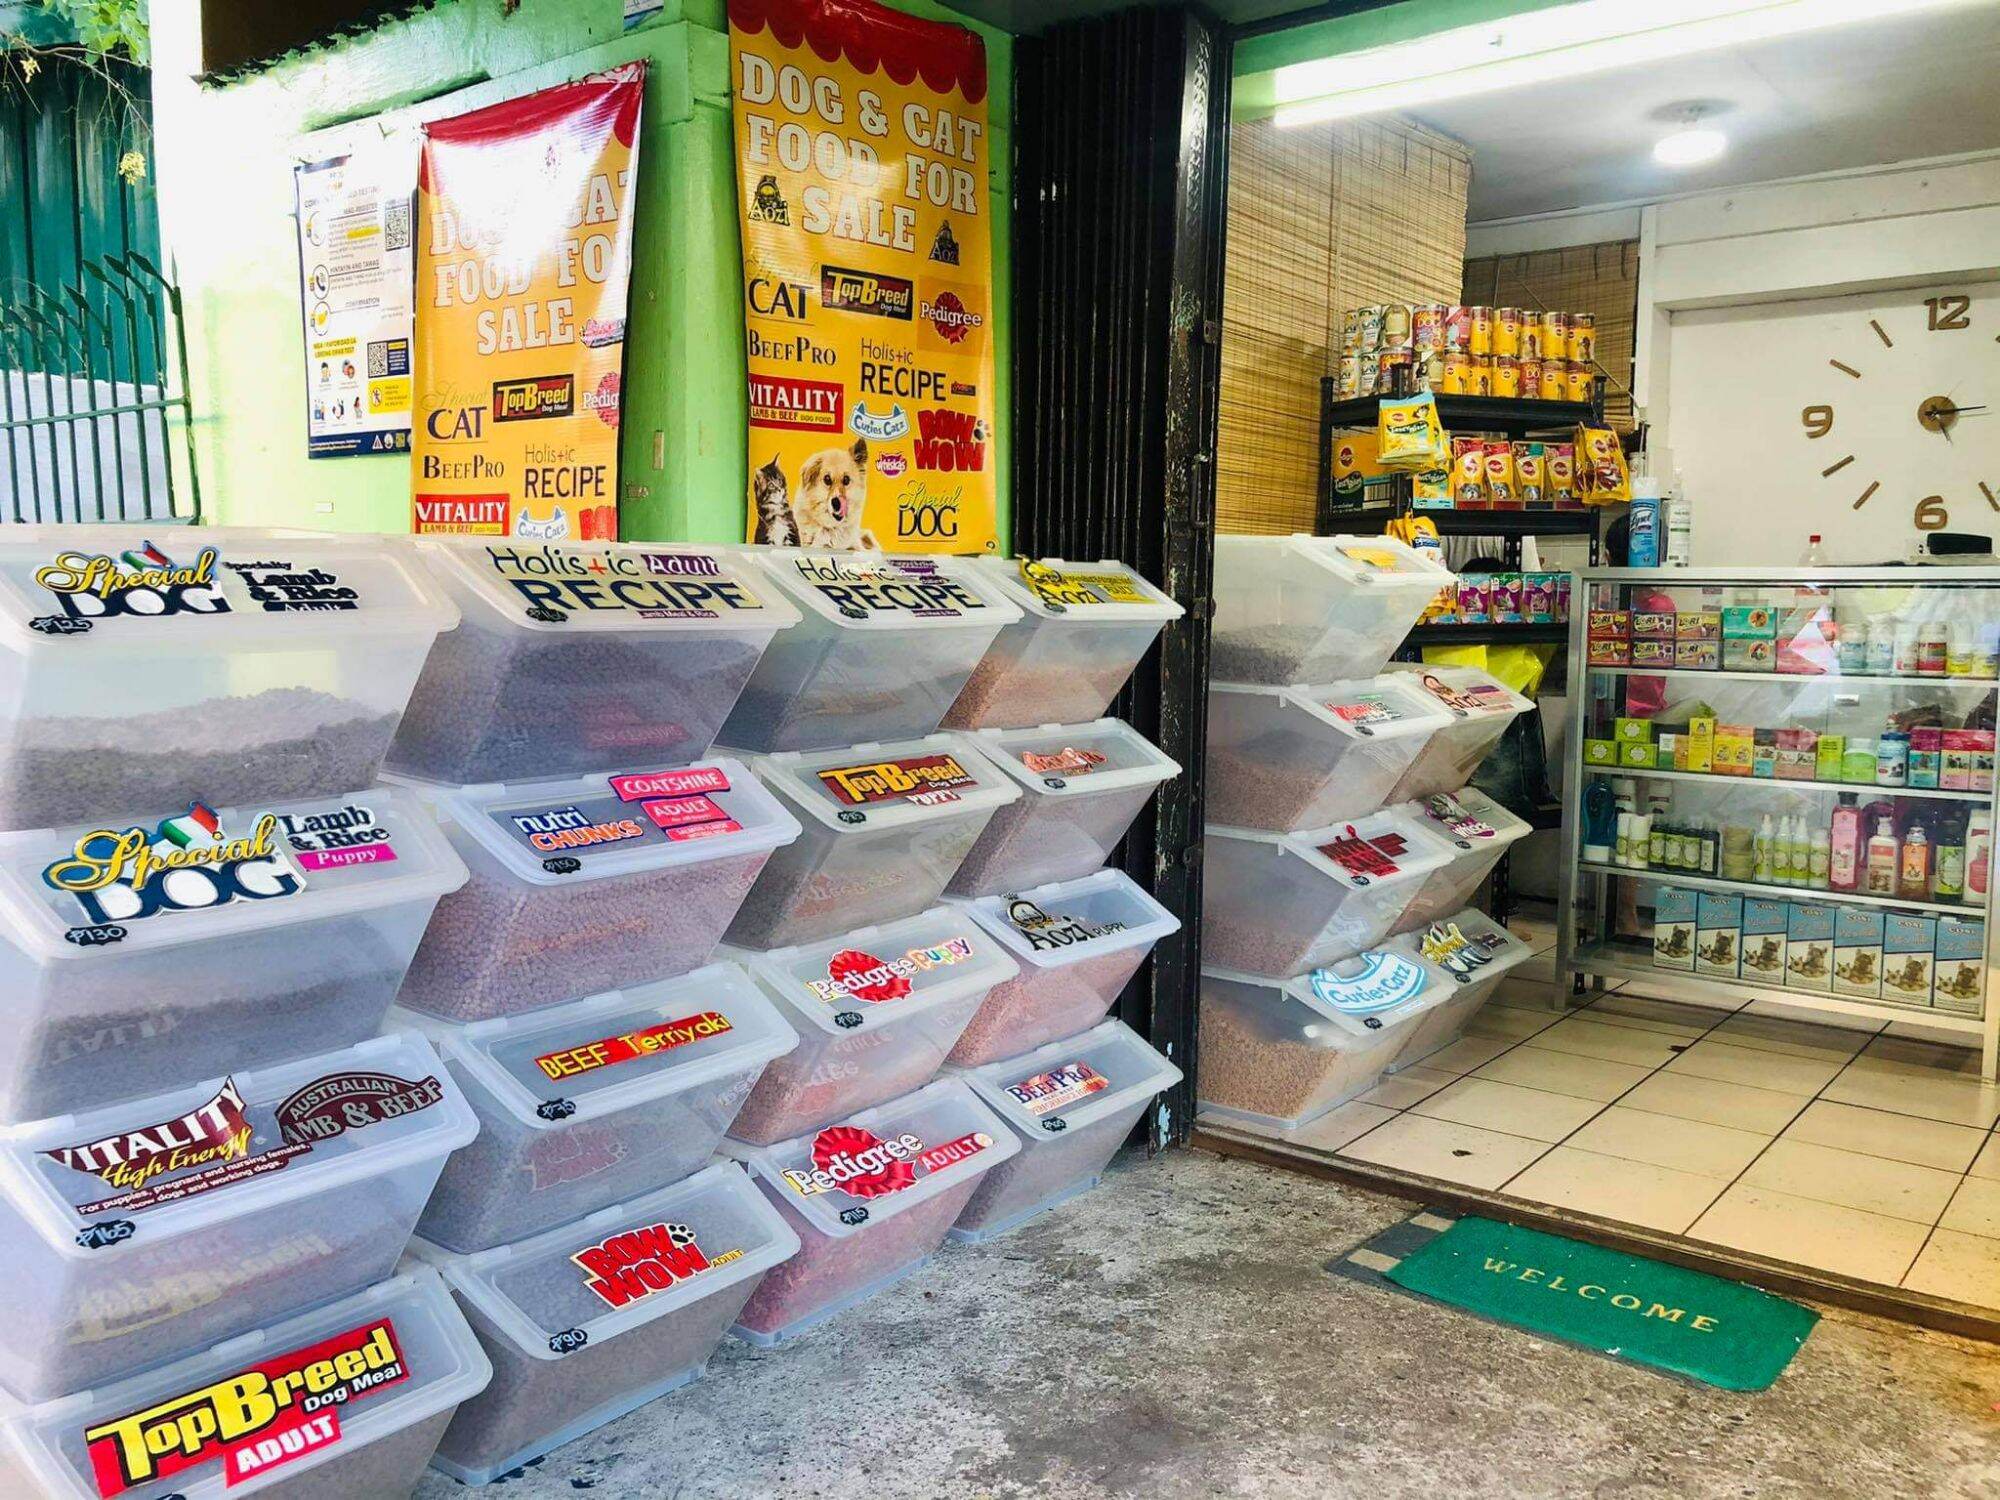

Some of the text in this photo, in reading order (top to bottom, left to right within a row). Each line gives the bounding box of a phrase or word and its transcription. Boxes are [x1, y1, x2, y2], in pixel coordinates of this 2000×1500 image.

[740, 51, 981, 163] DOG & CAT
[747, 114, 977, 215] FOOD FOR
[803, 186, 915, 253] SALE
[434, 254, 533, 307] FOOD
[557, 233, 617, 288] FO
[749, 279, 815, 320] CAT
[826, 273, 909, 308] TopBreed
[476, 297, 575, 355] SALE
[920, 301, 982, 329] Pedigree
[1924, 295, 1970, 331] 12
[861, 338, 914, 364] Holistic
[582, 389, 619, 409] Pedig
[749, 382, 838, 412] VITALITY
[860, 362, 946, 401] RECIPE
[497, 383, 570, 416] TopBreed
[752, 409, 769, 419] LAMB
[778, 410, 797, 421] BEEF
[427, 406, 488, 440] CAT
[917, 409, 976, 443] BOW
[1802, 405, 1834, 438] 9
[525, 444, 575, 463] Holistic
[914, 439, 985, 472] WOW
[525, 466, 606, 498] RECIPE
[416, 501, 506, 523] VITALITY
[898, 504, 958, 537] DOG
[1914, 495, 1948, 530] 6
[36, 548, 217, 597] Special
[236, 569, 337, 586] Lamb
[486, 546, 720, 576] Holistic Adult
[795, 557, 896, 582] Holistic
[55, 585, 233, 617] DOG
[248, 585, 359, 600] & Rice
[509, 578, 763, 610] RECIPE
[814, 584, 986, 610] RECIPE
[623, 769, 721, 794] COATSHINE
[818, 757, 964, 802] TopBreed
[281, 806, 371, 836] Lamb
[513, 799, 709, 832] nutri ADULT
[49, 814, 278, 889] Special
[287, 826, 390, 851] & Rice
[531, 820, 643, 851] CHUNKS
[317, 848, 377, 867] Puppy
[73, 855, 300, 924] DOG
[1021, 916, 1095, 951] Aozi
[807, 957, 920, 1000] Pedigree
[1329, 984, 1391, 1002] Cuties
[539, 1013, 732, 1080] BEEF Terriyaki
[283, 1075, 442, 1145] AMB & BEEF
[289, 1078, 398, 1121] AUSTRALIAN
[50, 1080, 246, 1174] VITALITY
[101, 1127, 251, 1189] High Energy
[782, 1133, 978, 1195] Pedigree ADULT
[78, 1203, 100, 1215] For
[103, 1190, 152, 1210] puppies,
[154, 1173, 204, 1194] pregnant
[205, 1166, 224, 1179] and
[226, 1154, 266, 1175] nursing
[125, 1198, 155, 1211] show
[157, 1187, 185, 1203] dogs
[188, 1181, 207, 1193] and
[209, 1168, 253, 1187] working
[576, 1224, 677, 1280] BOW
[589, 1242, 744, 1308] WOW ADULT
[1483, 1257, 1720, 1333] WELCOME
[86, 1327, 397, 1480] TopBreed
[304, 1364, 402, 1412] Dog Meal
[236, 1415, 334, 1475] ADULT
